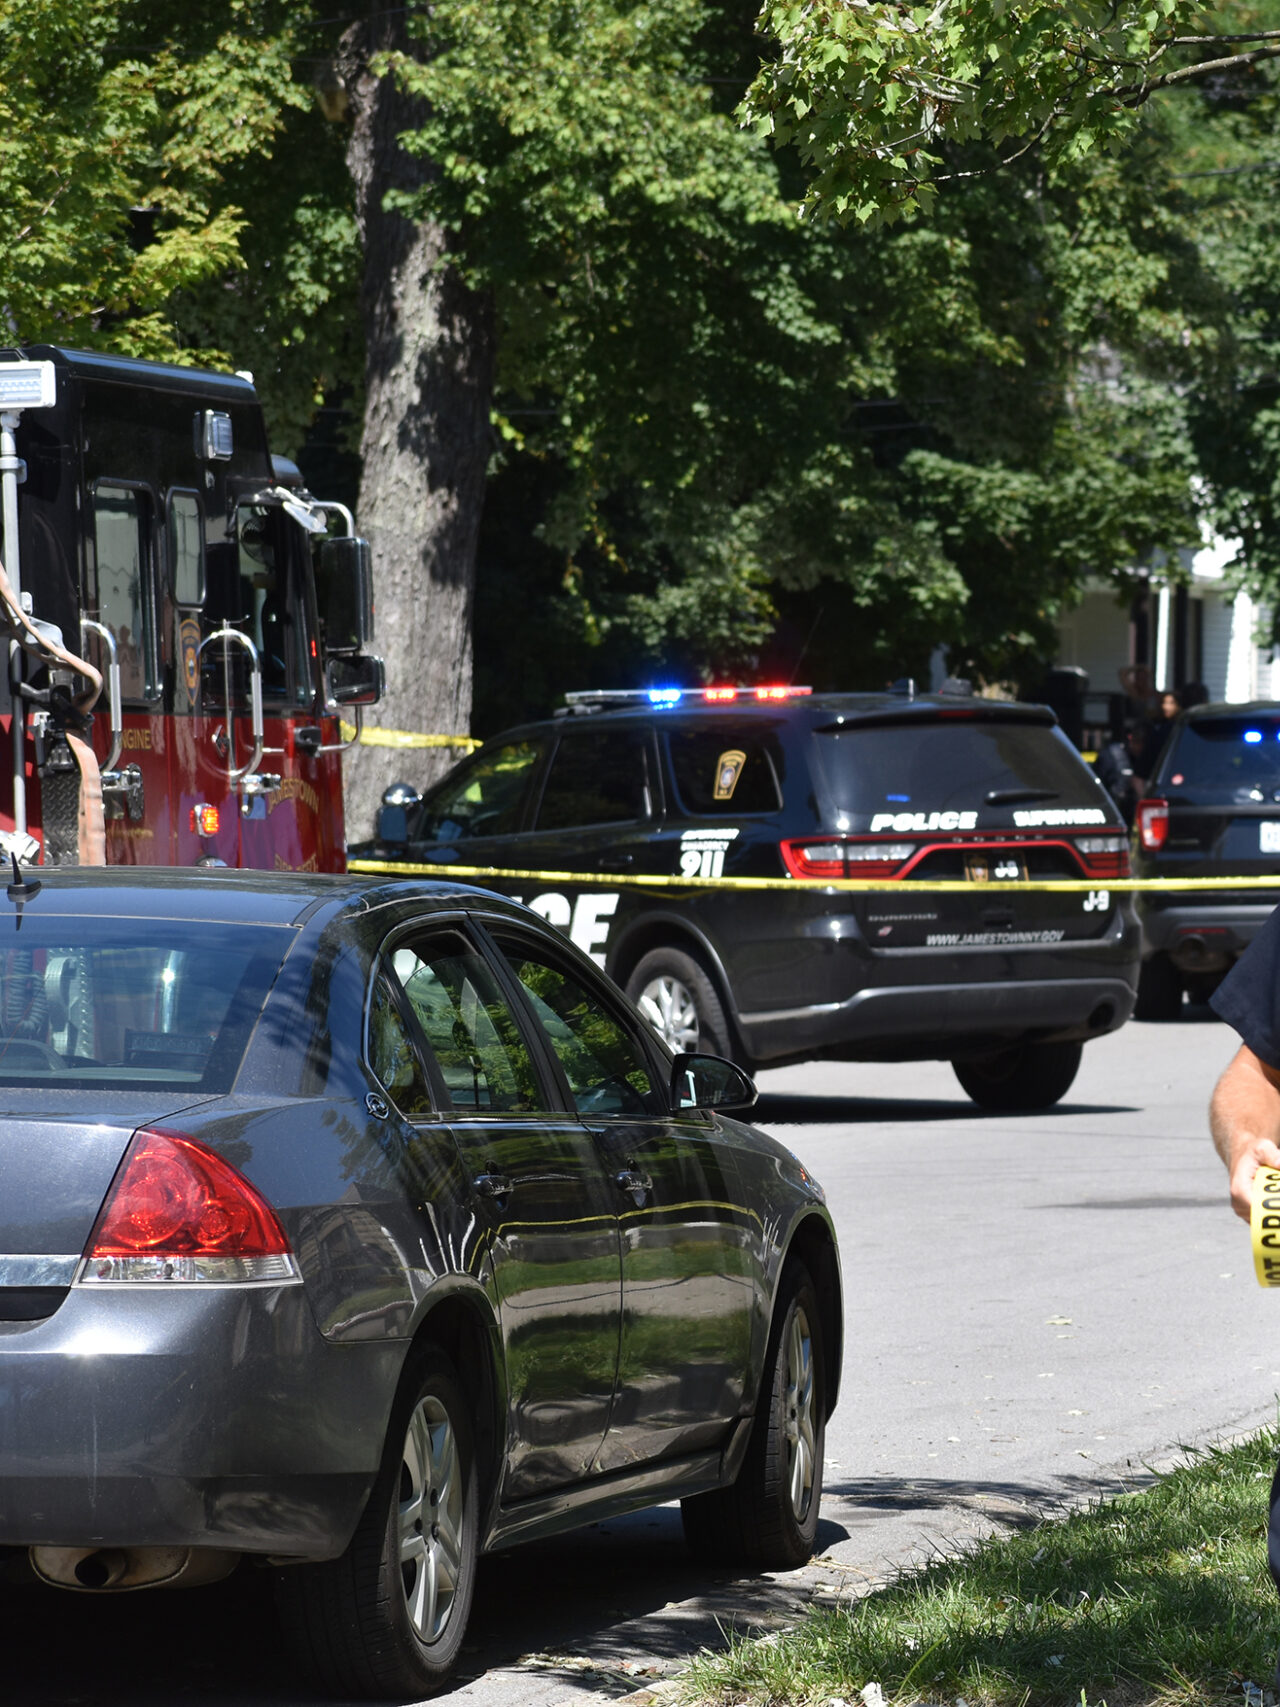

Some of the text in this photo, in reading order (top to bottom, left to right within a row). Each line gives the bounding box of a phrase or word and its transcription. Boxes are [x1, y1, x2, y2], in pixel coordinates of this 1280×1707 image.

[870, 811, 978, 832] POLICE
[680, 850, 725, 878] 911
[1083, 890, 1110, 912] J-9
[926, 930, 1065, 946] WWW.JAMESTOWNNY.GOV
